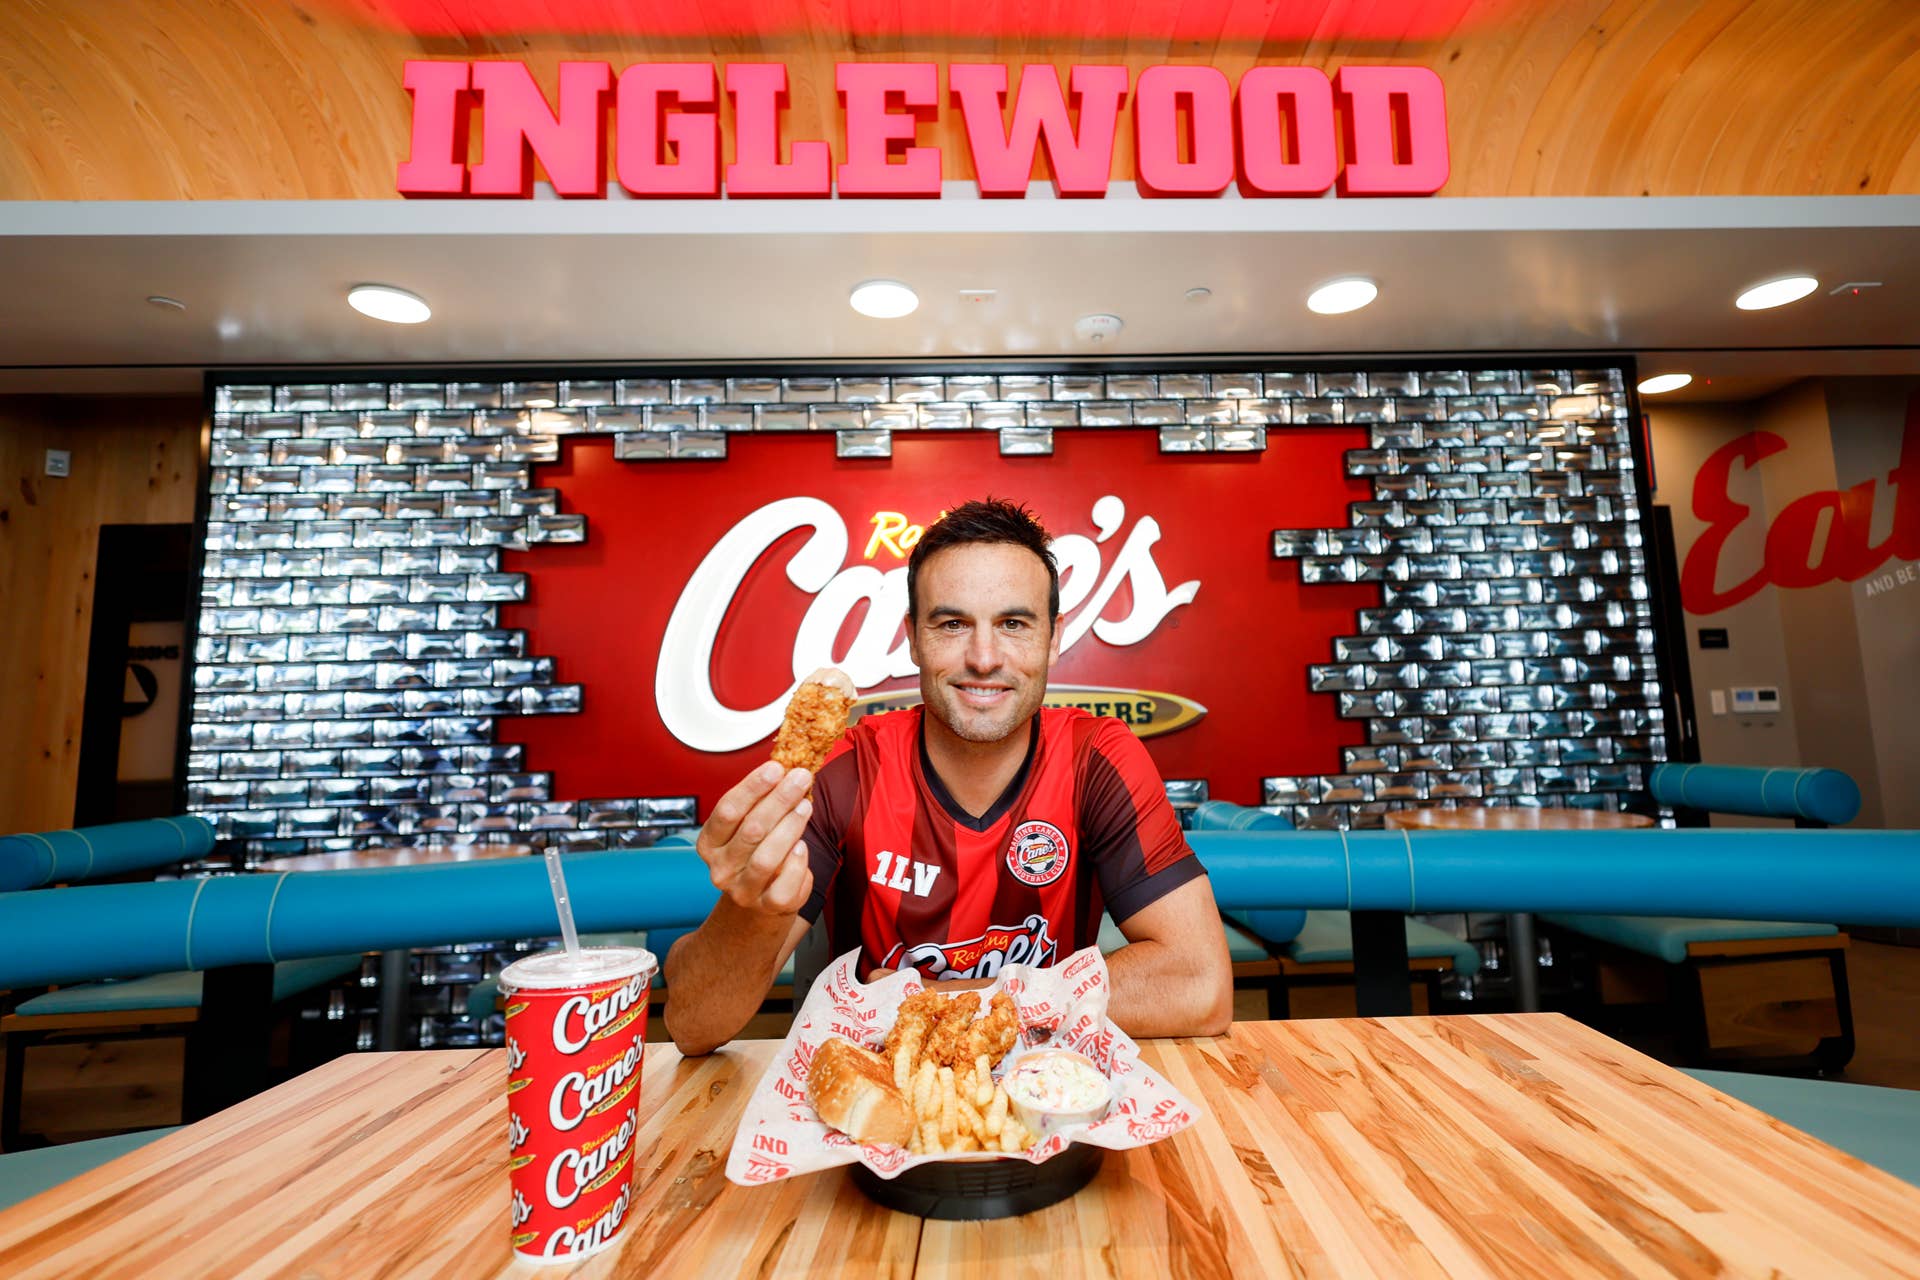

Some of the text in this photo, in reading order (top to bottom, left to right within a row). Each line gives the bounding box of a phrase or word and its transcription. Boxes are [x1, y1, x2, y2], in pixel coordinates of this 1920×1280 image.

[397, 59, 1452, 199] INGLEWOOD
[1866, 566, 1917, 597] AND BE
[655, 496, 1201, 752] Cae's
[1009, 826, 1033, 851] RAISING
[869, 850, 942, 898] 1LV
[1014, 855, 1065, 882] FOOTBALL CLUB
[1020, 1001, 1051, 1020] ONE
[1062, 1014, 1093, 1047] ONE
[549, 1035, 642, 1131] Cane's
[545, 1108, 636, 1208] Cane's
